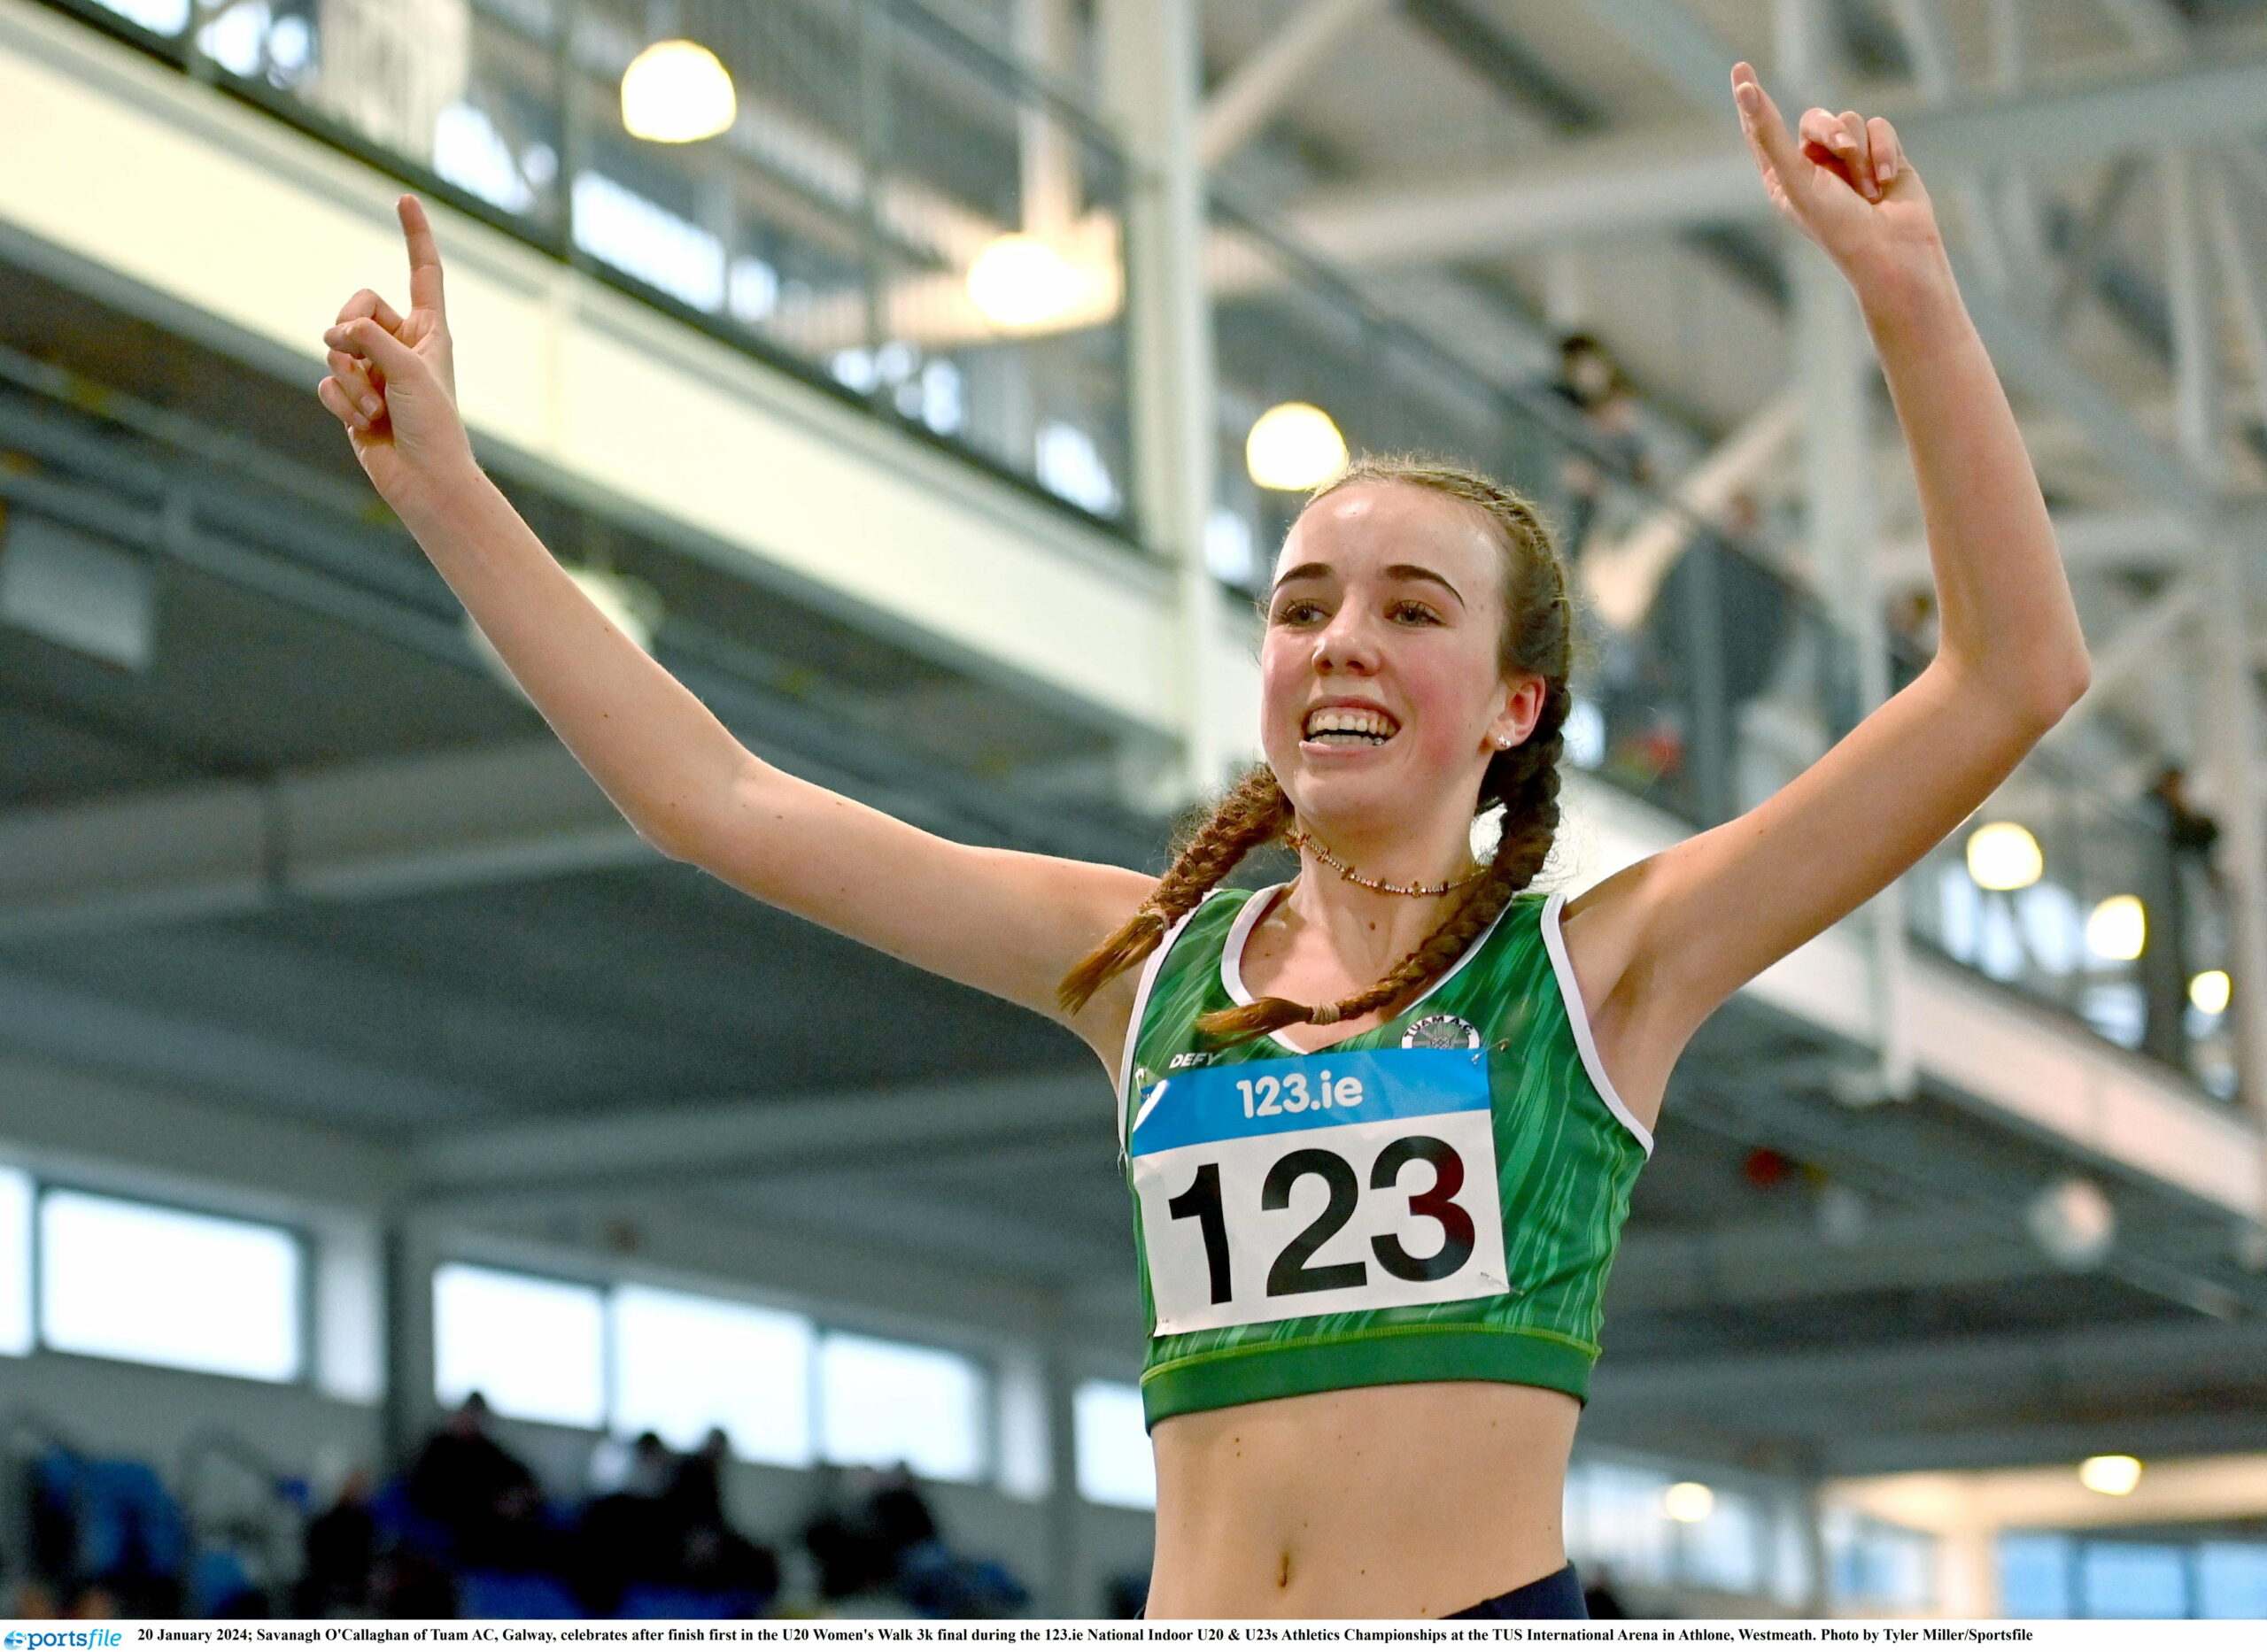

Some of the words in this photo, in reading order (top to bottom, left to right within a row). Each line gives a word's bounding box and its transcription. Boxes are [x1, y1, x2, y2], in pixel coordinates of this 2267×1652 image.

[1404, 1015, 1444, 1038] TUAM
[1168, 1052, 1223, 1069] DEFY
[1235, 1069, 1364, 1120] 123.ie
[1167, 1135, 1476, 1306] 123
